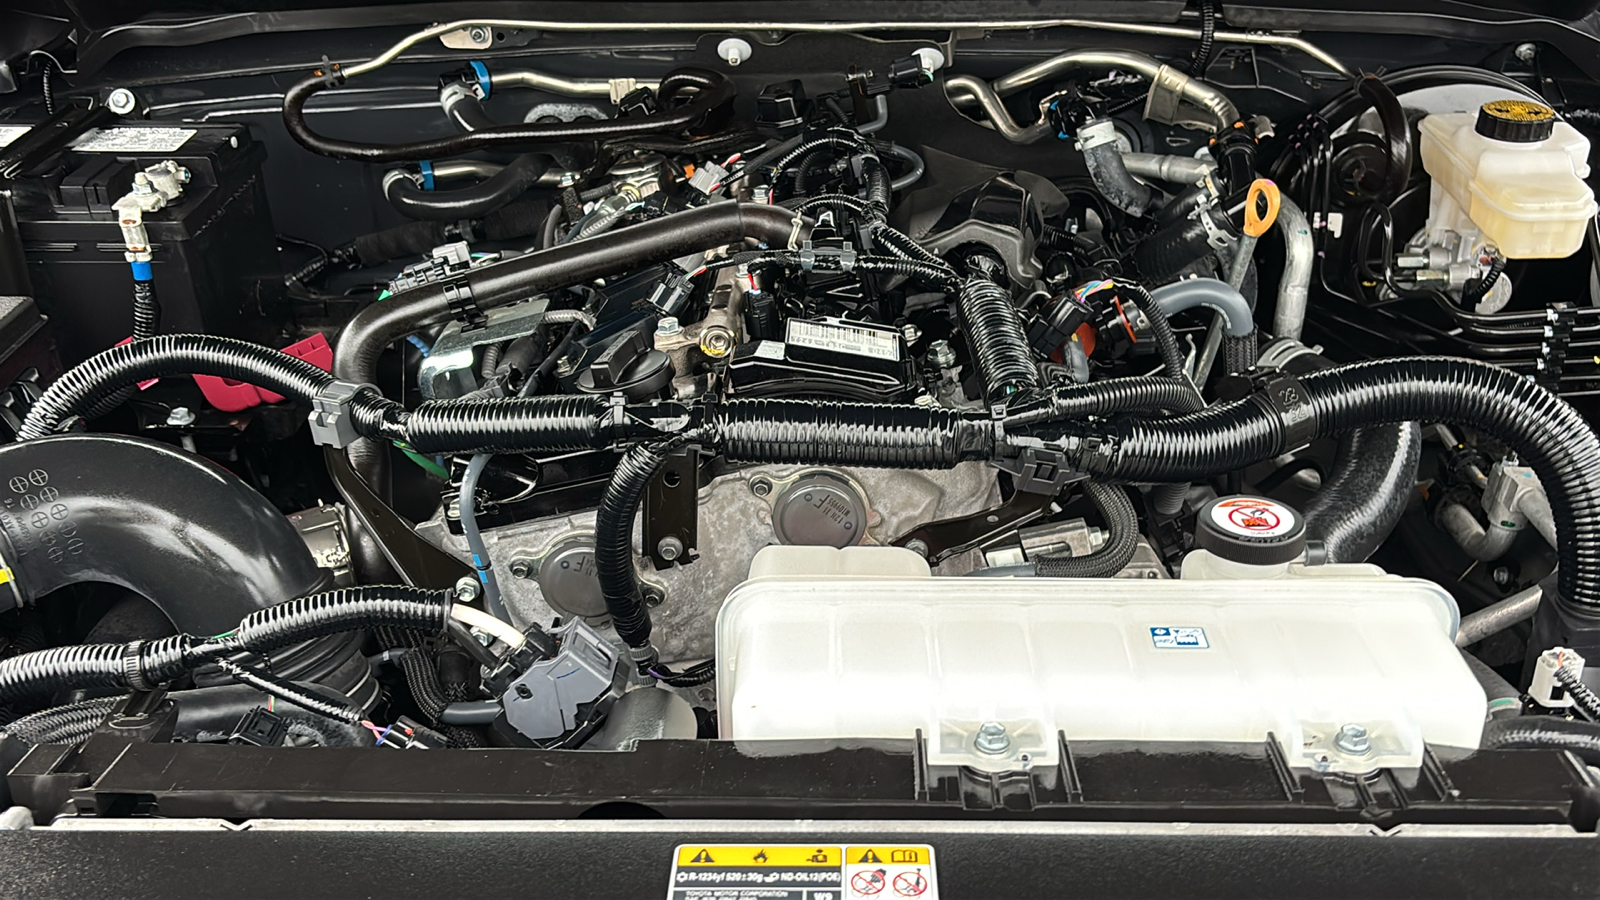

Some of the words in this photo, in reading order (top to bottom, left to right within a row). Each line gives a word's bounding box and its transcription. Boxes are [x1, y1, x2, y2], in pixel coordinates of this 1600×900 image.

[813, 494, 830, 509] F
[573, 555, 585, 572] F
[689, 872, 726, 883] R-1234yf
